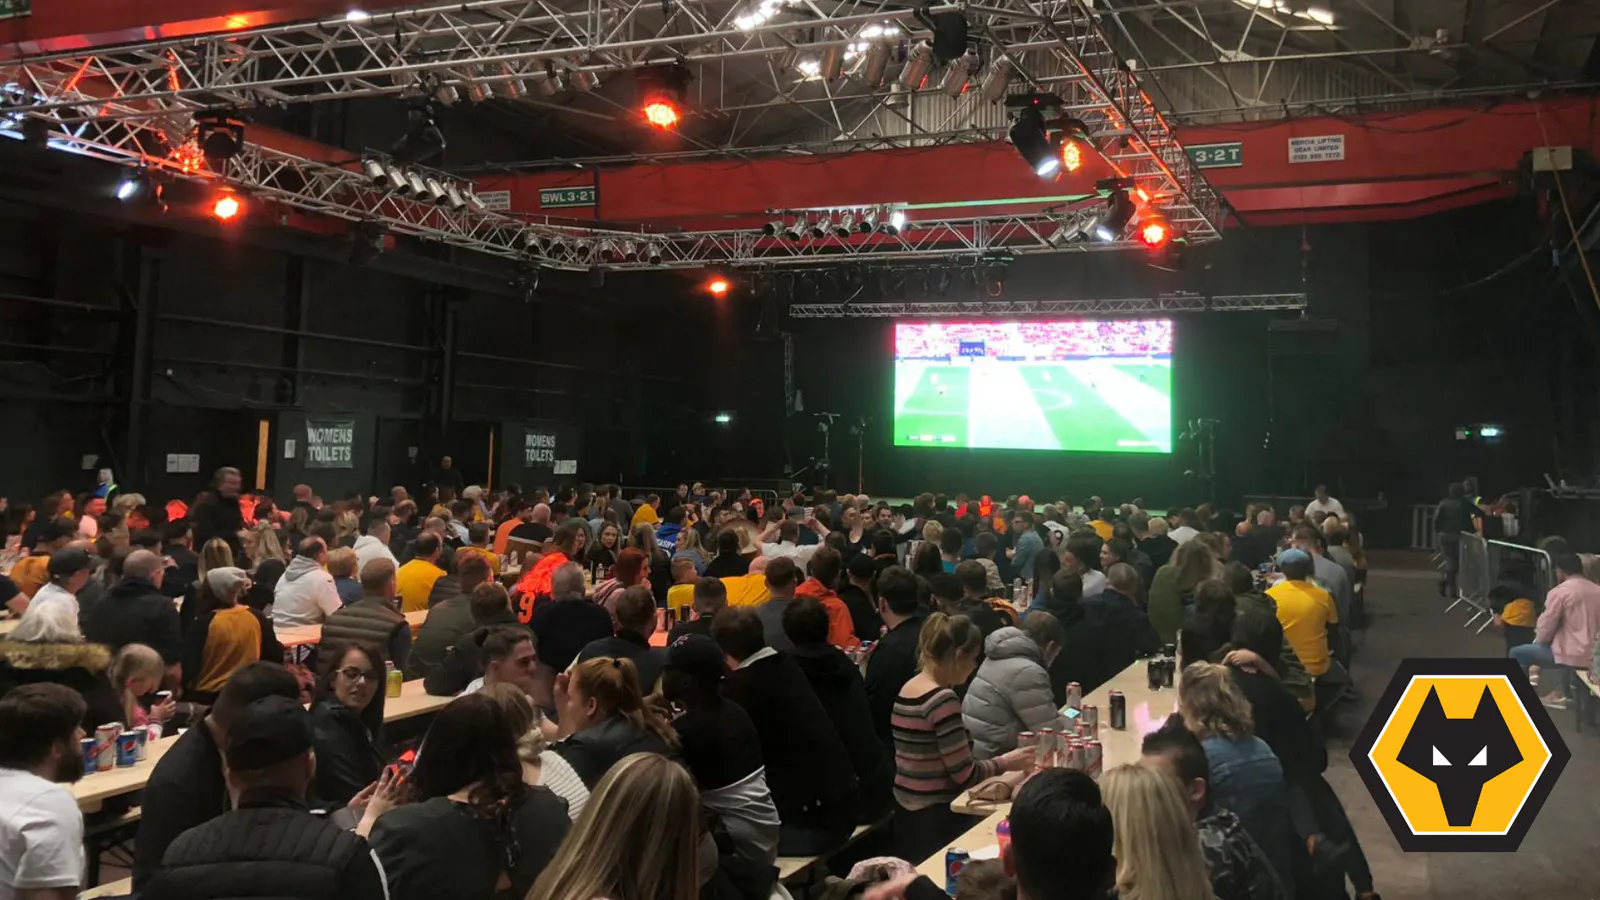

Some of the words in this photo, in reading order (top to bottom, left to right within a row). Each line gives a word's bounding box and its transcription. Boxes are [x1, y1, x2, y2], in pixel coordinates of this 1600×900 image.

[541, 192, 566, 203] SWL
[307, 428, 353, 443] WOMENS
[525, 434, 556, 447] WOMENS
[307, 445, 352, 461] TOILETS
[525, 448, 554, 462] TOILETS
[518, 591, 535, 624] 9
